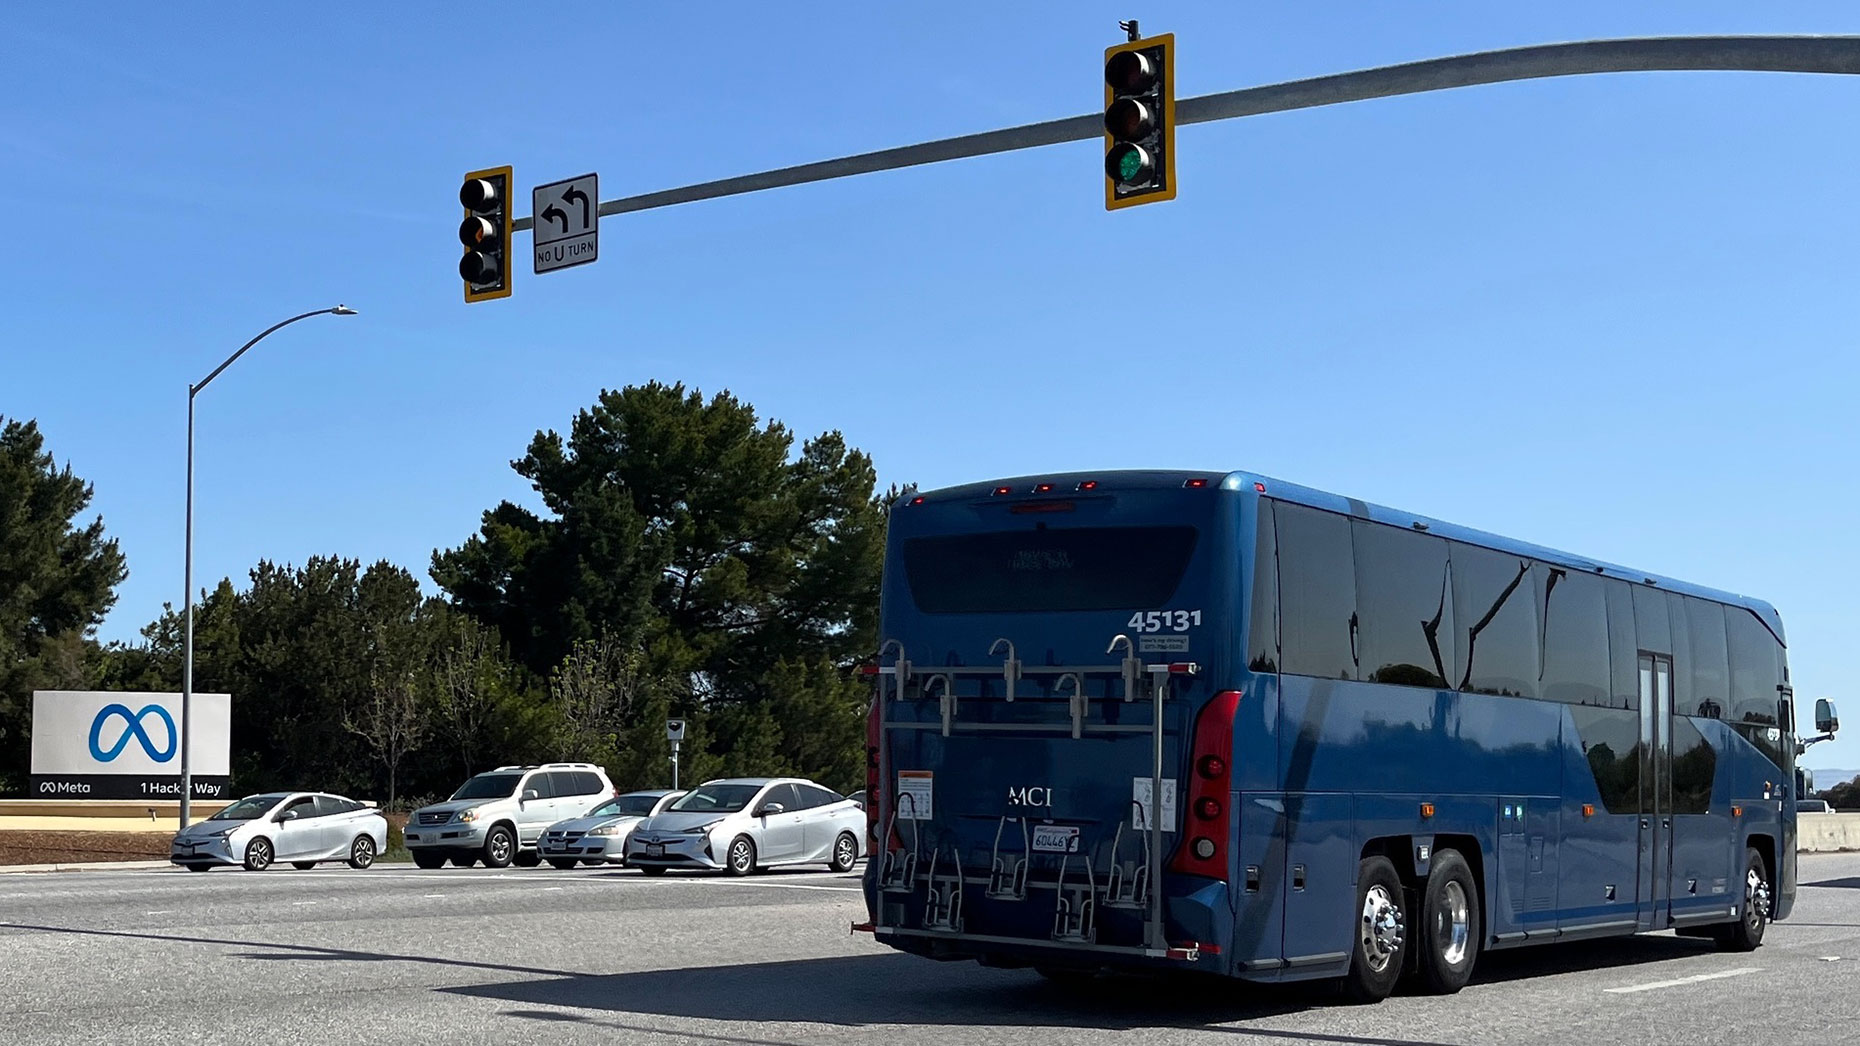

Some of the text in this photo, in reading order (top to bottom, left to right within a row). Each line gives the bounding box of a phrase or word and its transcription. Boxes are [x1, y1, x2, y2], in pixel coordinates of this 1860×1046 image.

[538, 241, 594, 263] NO U TURN
[1127, 609, 1202, 633] 45131
[57, 782, 91, 793] Meta
[140, 782, 222, 797] 1 Hack Way
[1008, 786, 1052, 807] MCI
